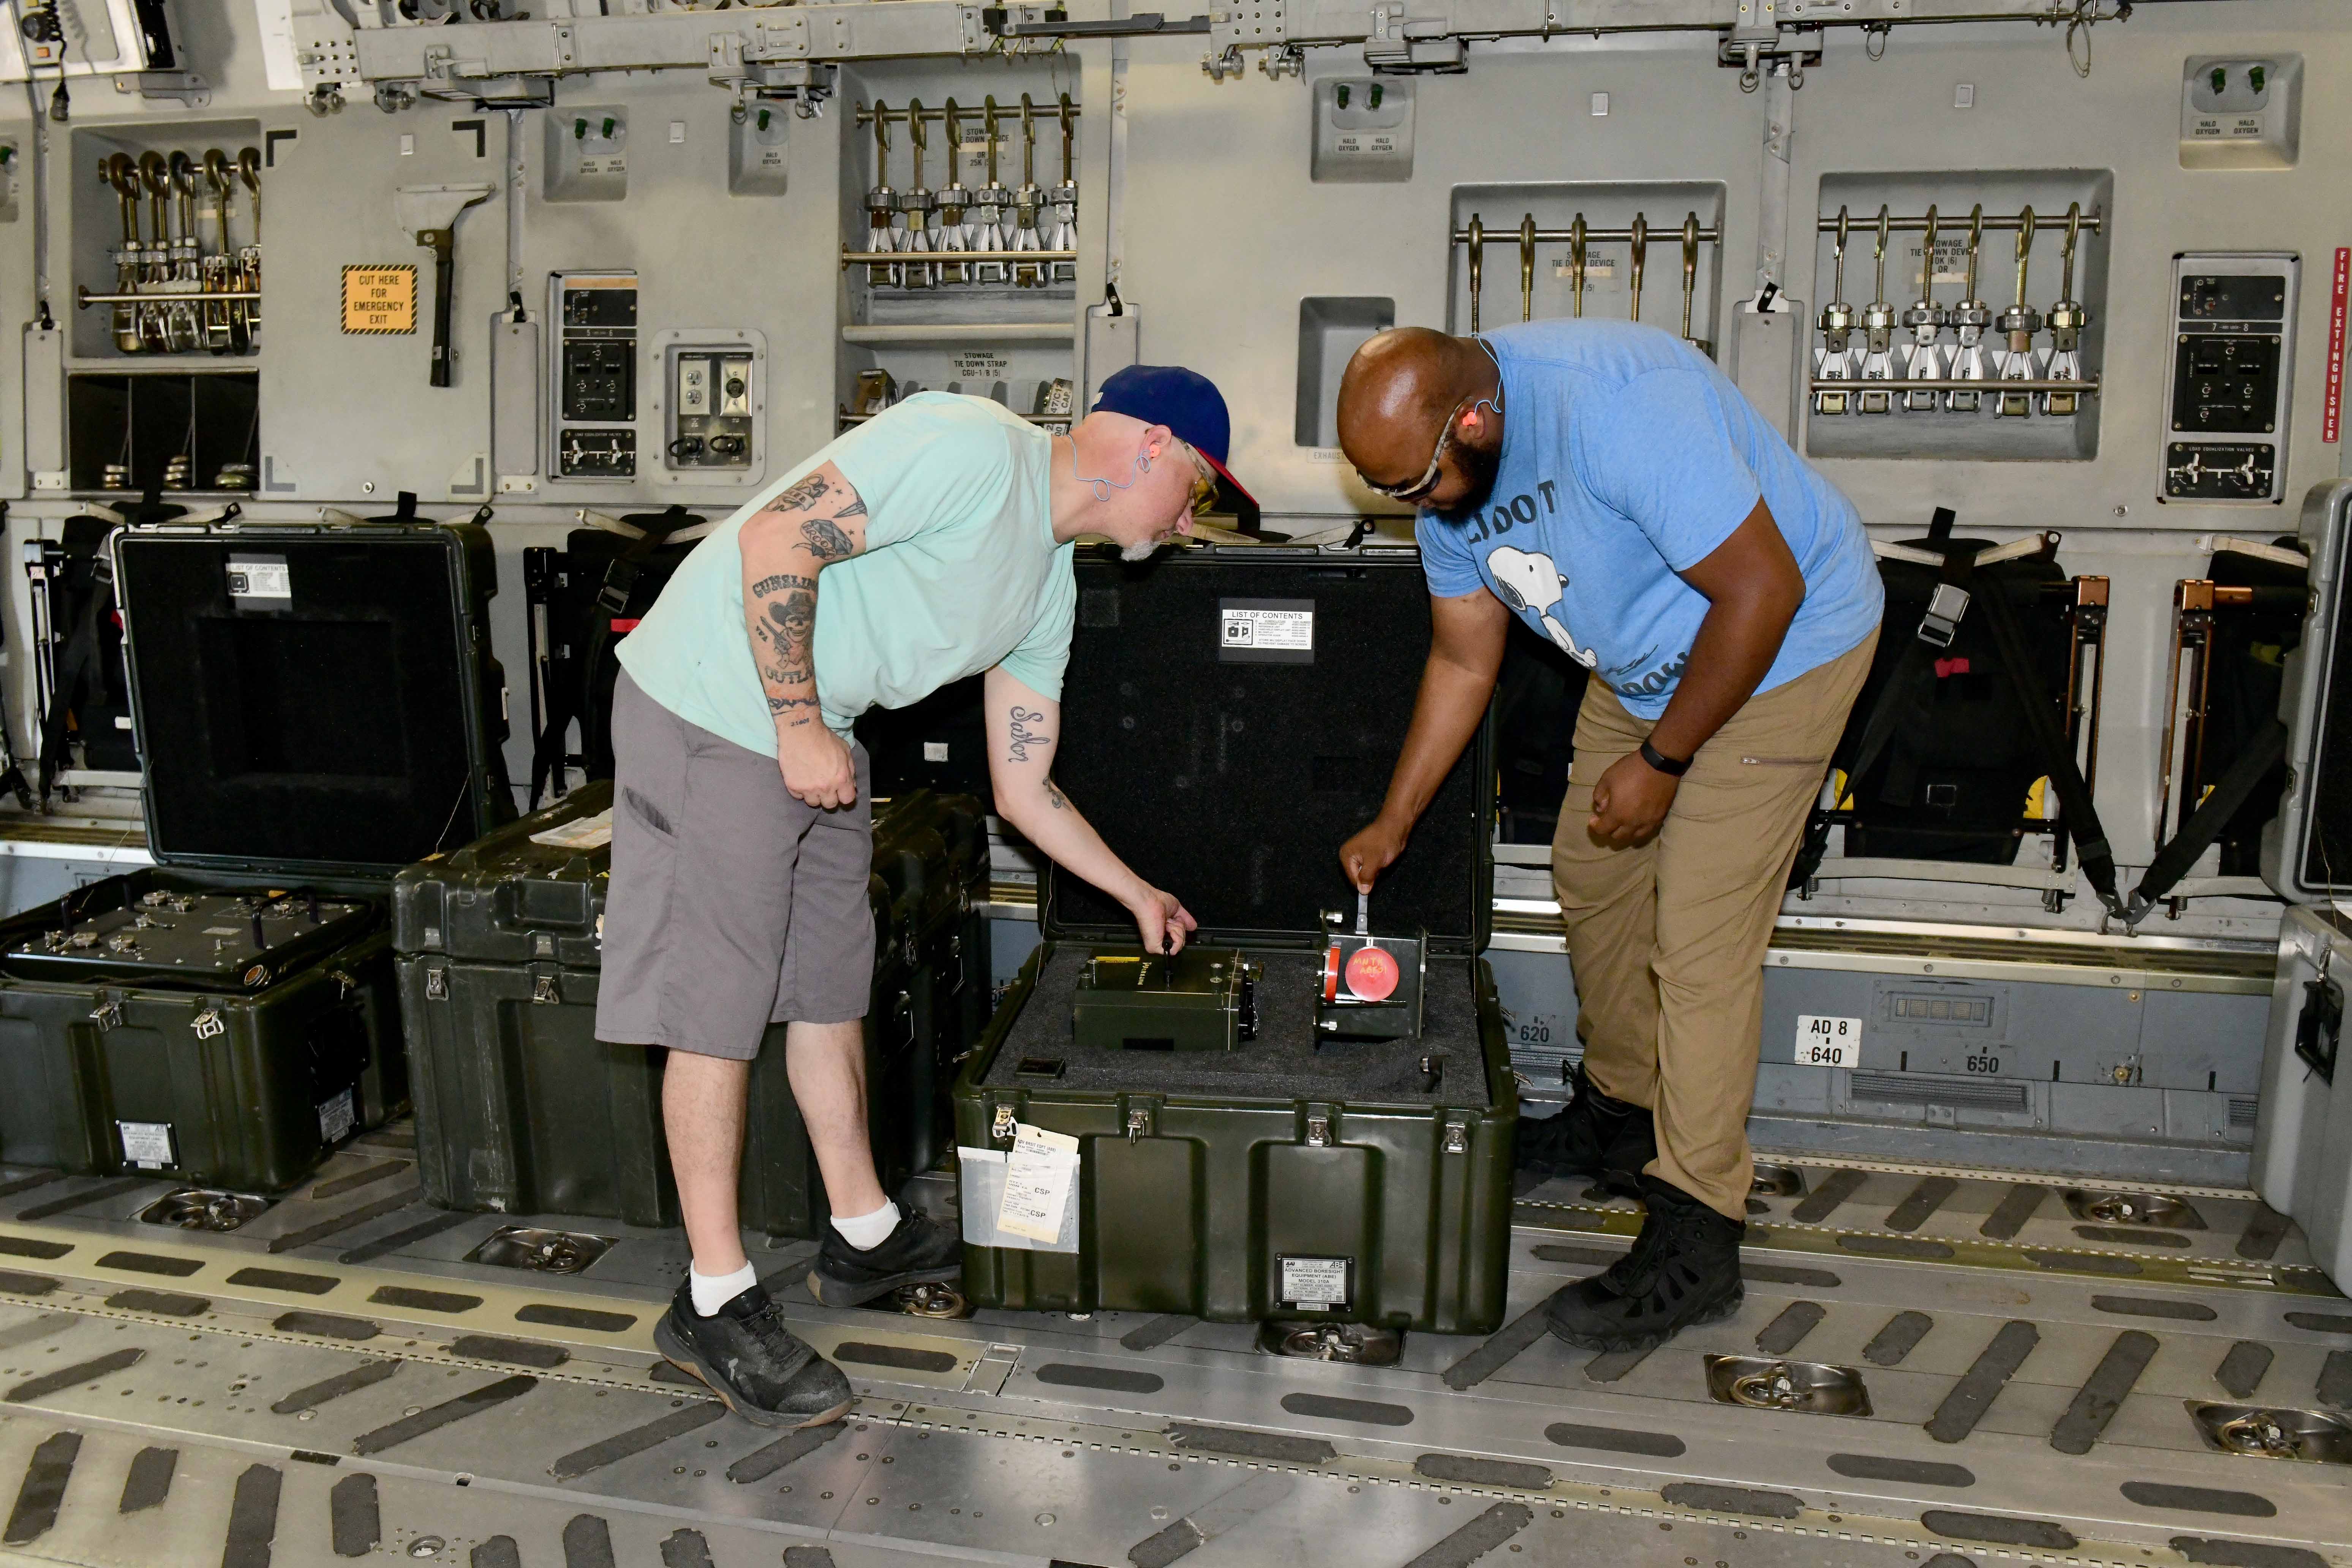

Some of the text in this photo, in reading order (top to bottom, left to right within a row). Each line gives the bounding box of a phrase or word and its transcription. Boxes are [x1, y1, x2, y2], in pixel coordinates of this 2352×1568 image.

[1948, 257, 1957, 265] (6)
[359, 275, 400, 285] CUT HERE
[371, 289, 387, 298] FOR
[354, 302, 404, 311] EMERGENCY
[370, 315, 387, 324] EXIT
[2327, 251, 2346, 439] FIRE EXTINGUISHER
[752, 574, 818, 598] GUNSLIN
[1521, 1025, 1549, 1042] 620
[1811, 1019, 1848, 1035] AD 8
[1811, 1046, 1842, 1064] 640
[1967, 1056, 1999, 1073] 650
